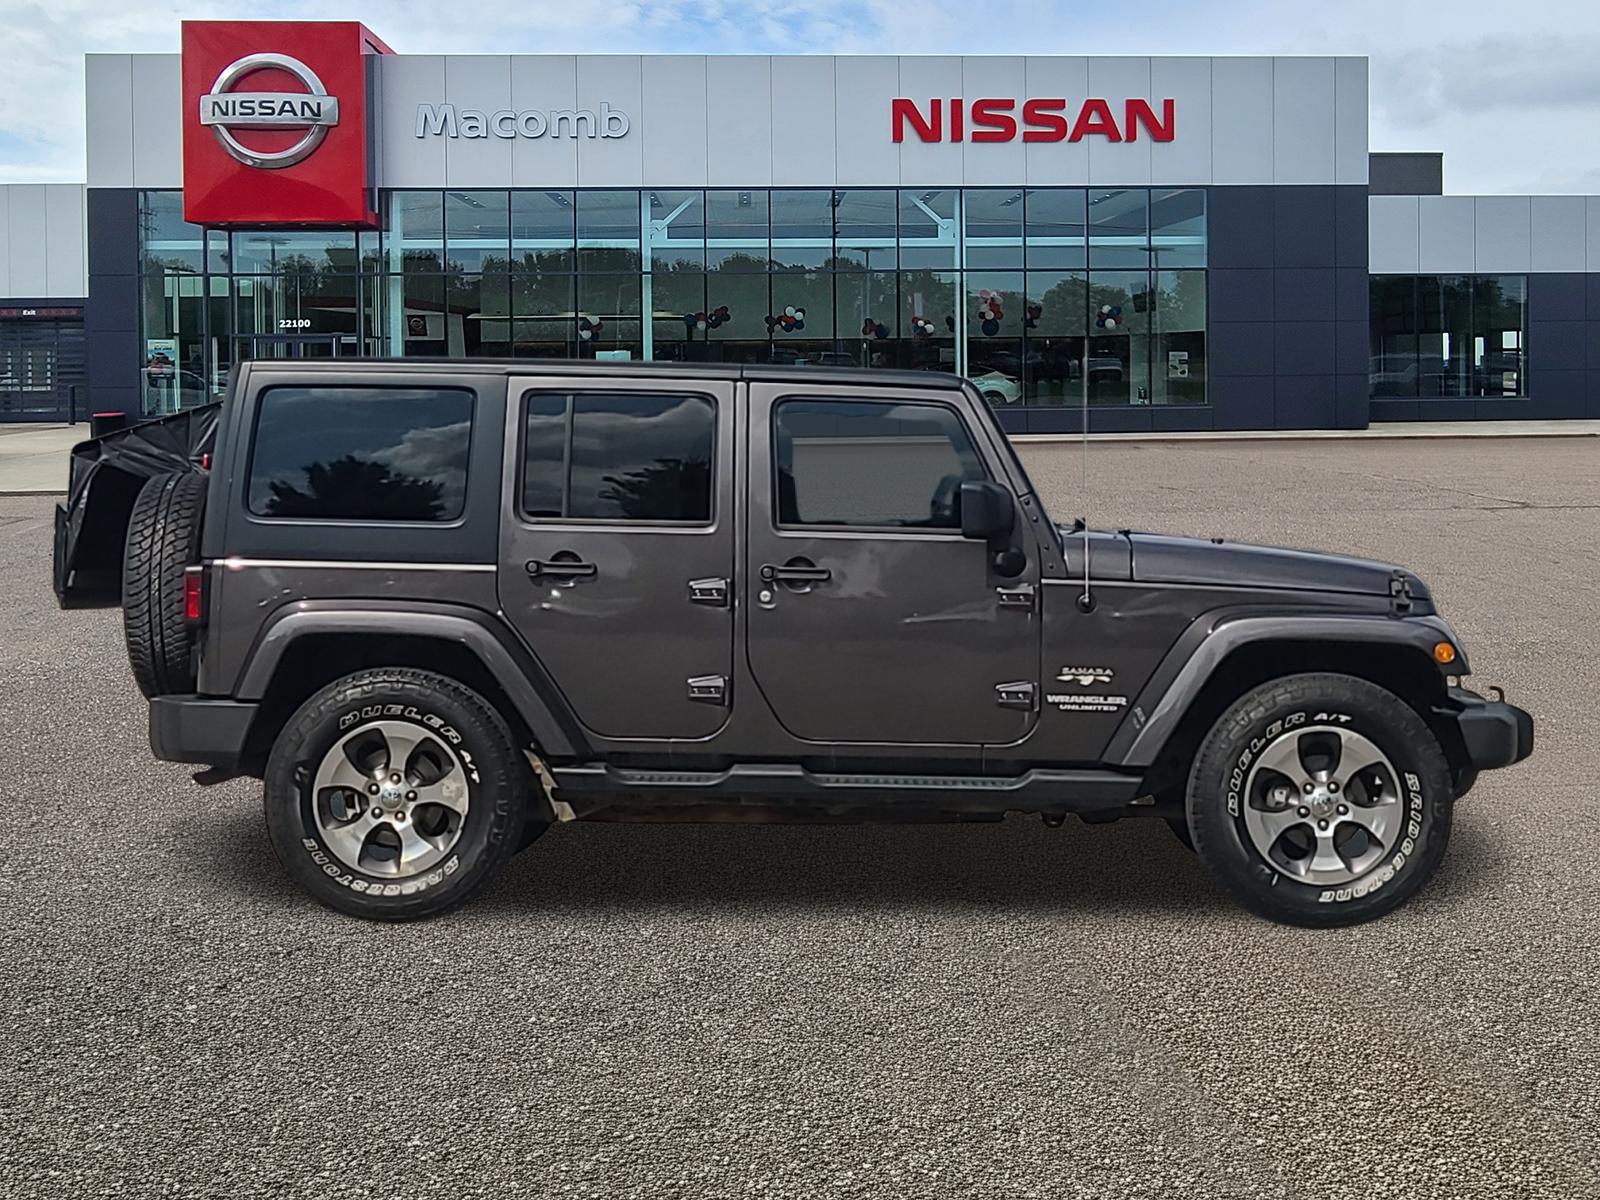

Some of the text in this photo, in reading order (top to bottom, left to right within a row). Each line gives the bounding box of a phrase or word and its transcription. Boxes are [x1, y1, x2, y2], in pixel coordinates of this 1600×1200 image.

[211, 100, 322, 117] NISSAN
[415, 102, 630, 139] Macomb
[892, 98, 1175, 143] NISSAN
[279, 319, 311, 328] 22100
[1046, 694, 1127, 706] WRANGLER
[338, 704, 481, 784] DUELER A/T
[1226, 712, 1353, 818] DUELER A/T
[1318, 771, 1423, 903] BRIDGESTONE
[301, 837, 460, 896] BRIDGESTONE
